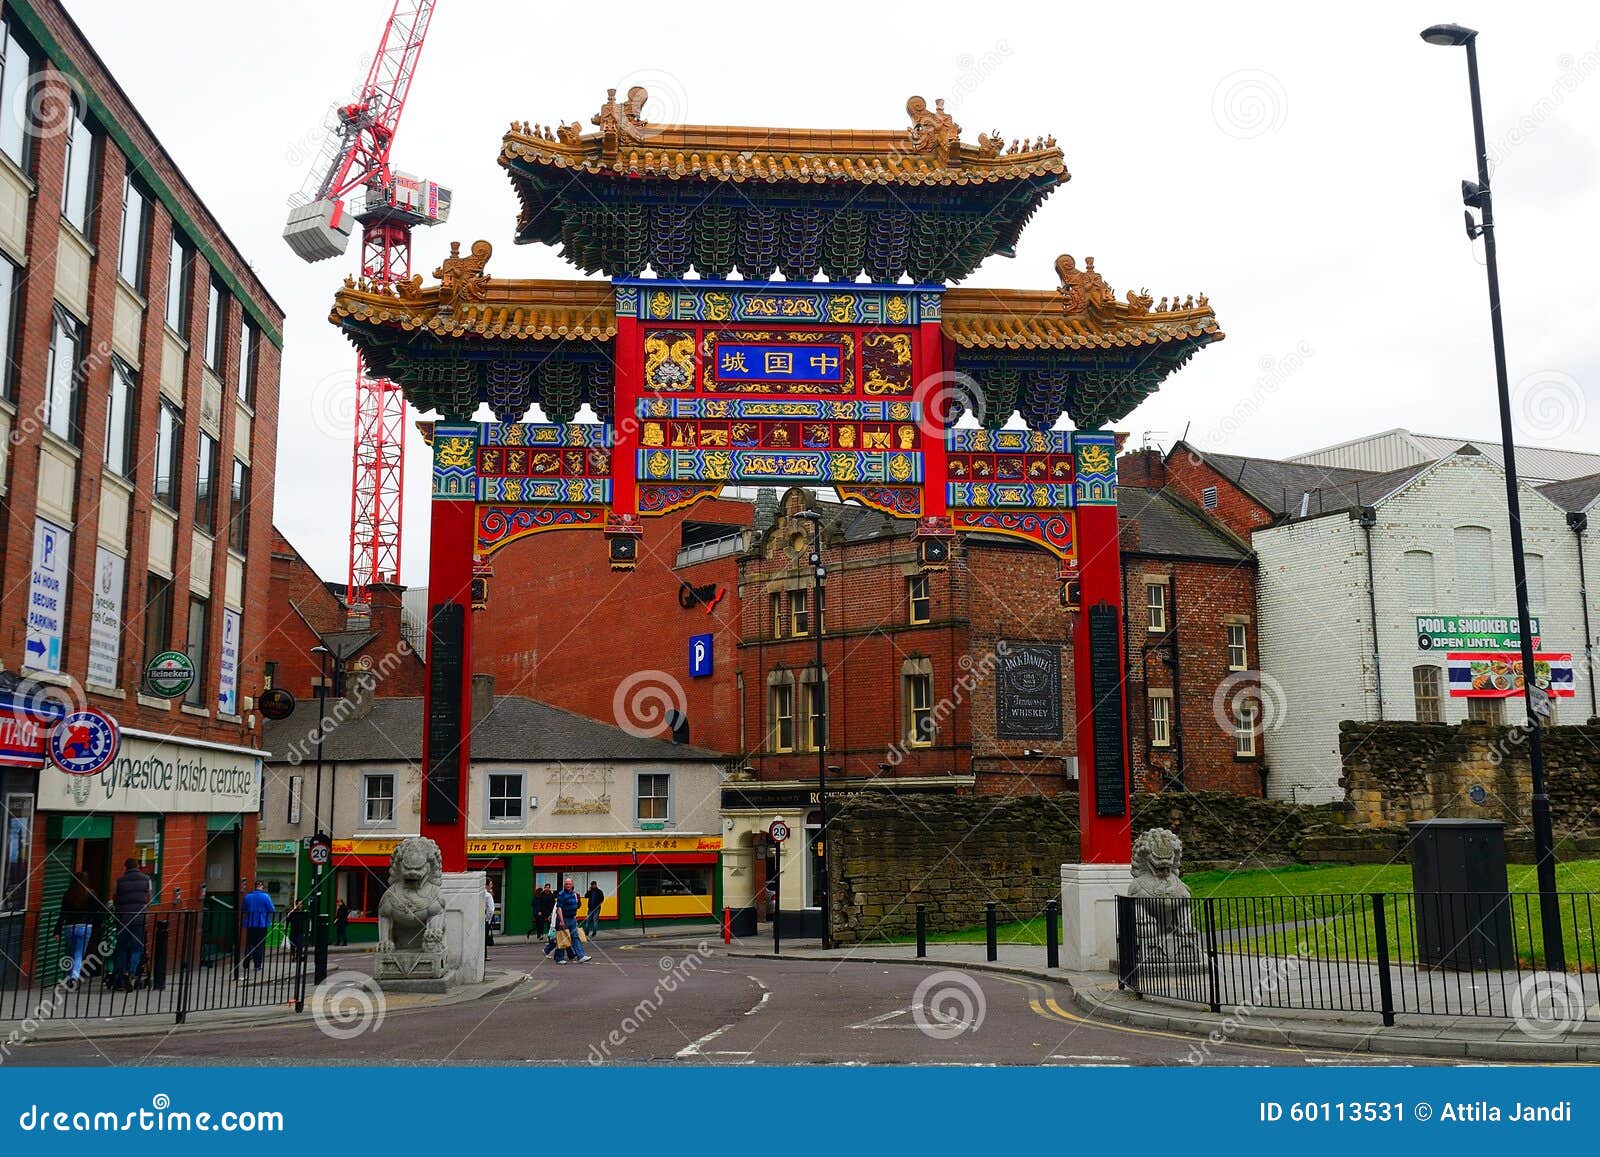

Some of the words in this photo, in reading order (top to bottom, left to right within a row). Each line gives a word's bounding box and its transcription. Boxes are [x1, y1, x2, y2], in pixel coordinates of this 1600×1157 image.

[44, 535, 54, 564] P
[33, 571, 41, 585] 24
[42, 575, 60, 592] HOUR
[32, 592, 57, 612] SECURE
[29, 612, 58, 632] PARKING
[1418, 618, 1446, 633] POOL
[1448, 620, 1457, 633] &
[1458, 619, 1509, 634] SNOOKER
[1510, 619, 1538, 634] CB
[1433, 637, 1464, 648] OPEN
[1467, 638, 1500, 648] UNTIL
[695, 644, 705, 672] P
[1004, 655, 1023, 672] JACK
[151, 670, 189, 678] Heineken
[1011, 708, 1048, 718] WHISKEY
[55, 747, 109, 772] COTTAGE
[773, 827, 786, 837] 20
[312, 848, 327, 858] 20
[491, 842, 522, 851] Town
[532, 841, 578, 850] EXPRESS
